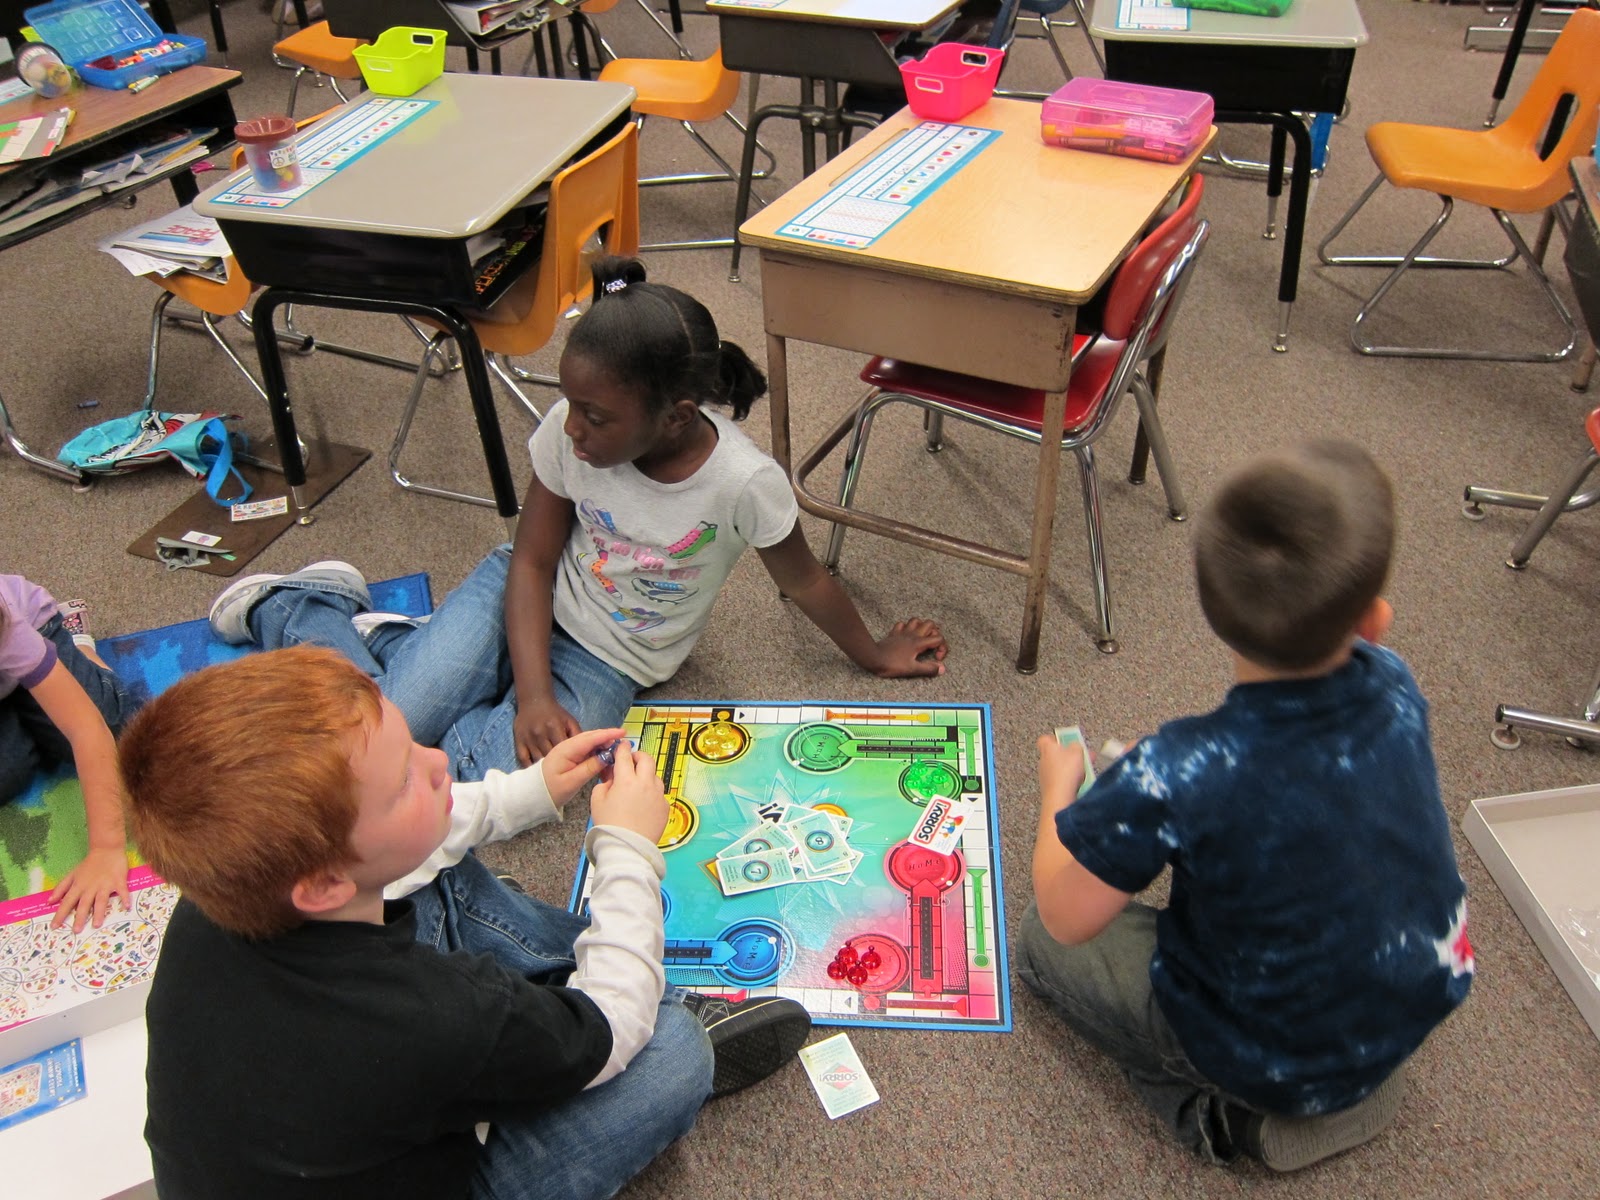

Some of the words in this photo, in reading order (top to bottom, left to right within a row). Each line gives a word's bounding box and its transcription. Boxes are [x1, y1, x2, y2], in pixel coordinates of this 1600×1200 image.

[918, 802, 947, 841] SORRY!
[814, 836, 825, 846] 8
[750, 867, 762, 876] 7
